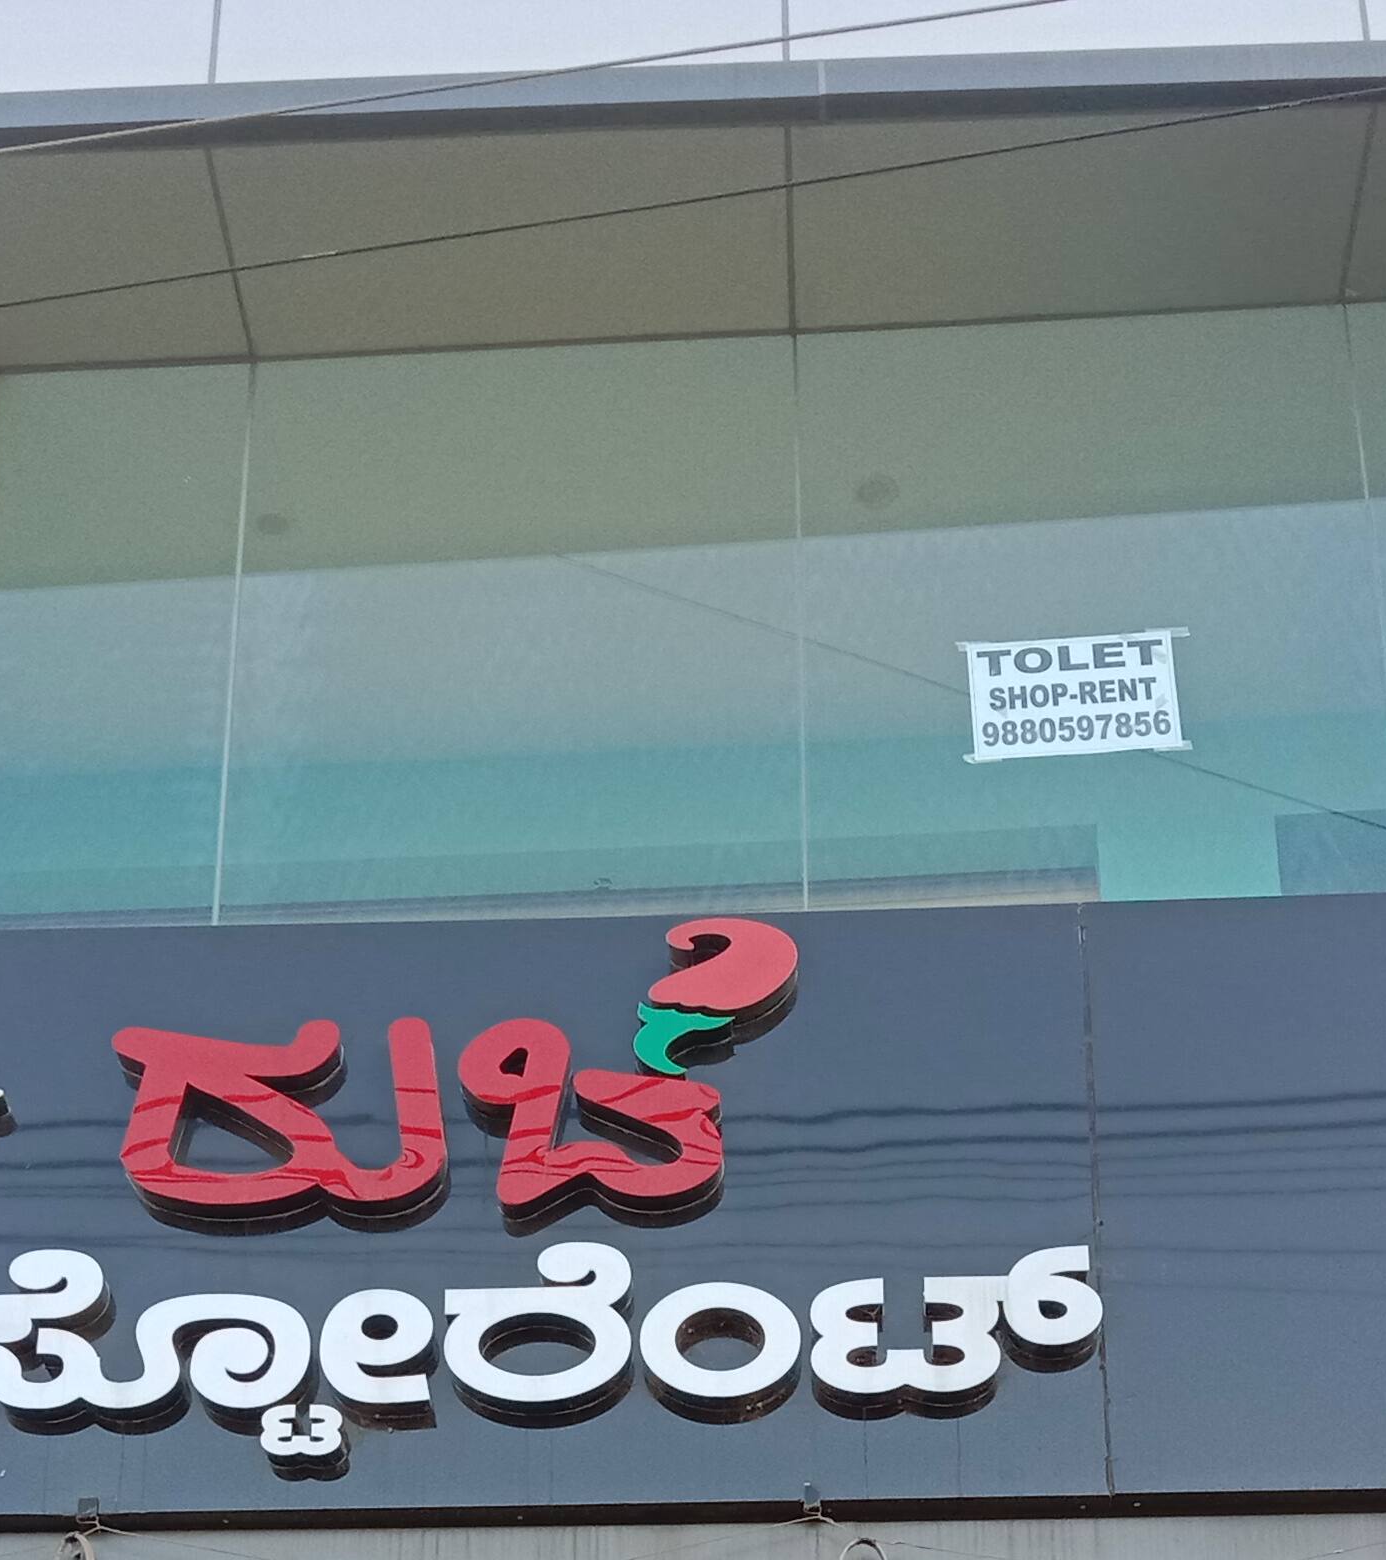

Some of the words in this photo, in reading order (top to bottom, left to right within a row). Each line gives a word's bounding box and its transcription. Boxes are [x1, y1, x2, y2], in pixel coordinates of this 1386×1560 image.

[976, 639, 1163, 677] TOLET
[989, 677, 1157, 710] SHOP-RENT
[982, 710, 1171, 746] 9880597856
[113, 918, 797, 1205] ರುಚಿ
